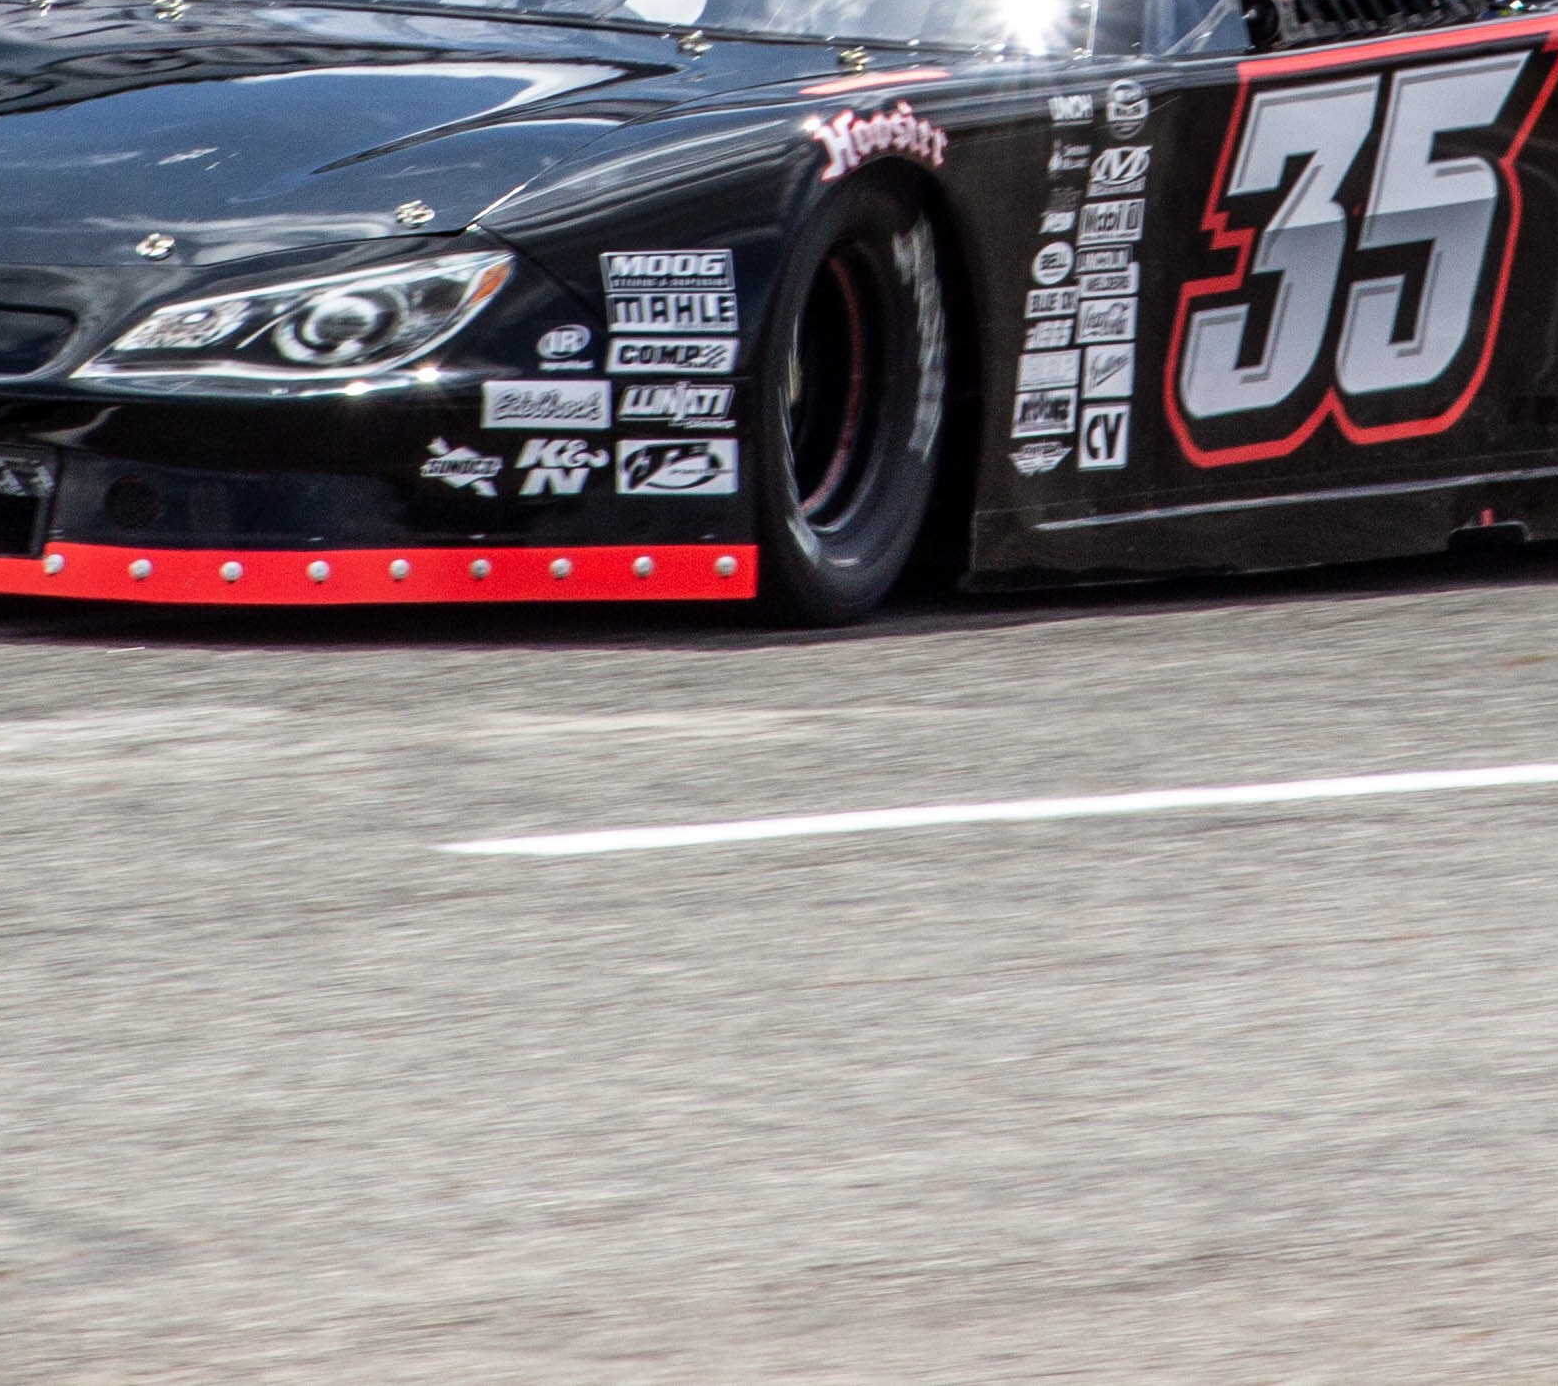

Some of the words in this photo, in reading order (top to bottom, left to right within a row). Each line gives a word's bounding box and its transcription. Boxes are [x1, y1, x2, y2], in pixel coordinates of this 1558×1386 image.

[812, 101, 948, 181] Hoosier
[1179, 50, 1533, 420] 35
[609, 254, 727, 277] MOOG
[612, 295, 735, 323] MAHLE
